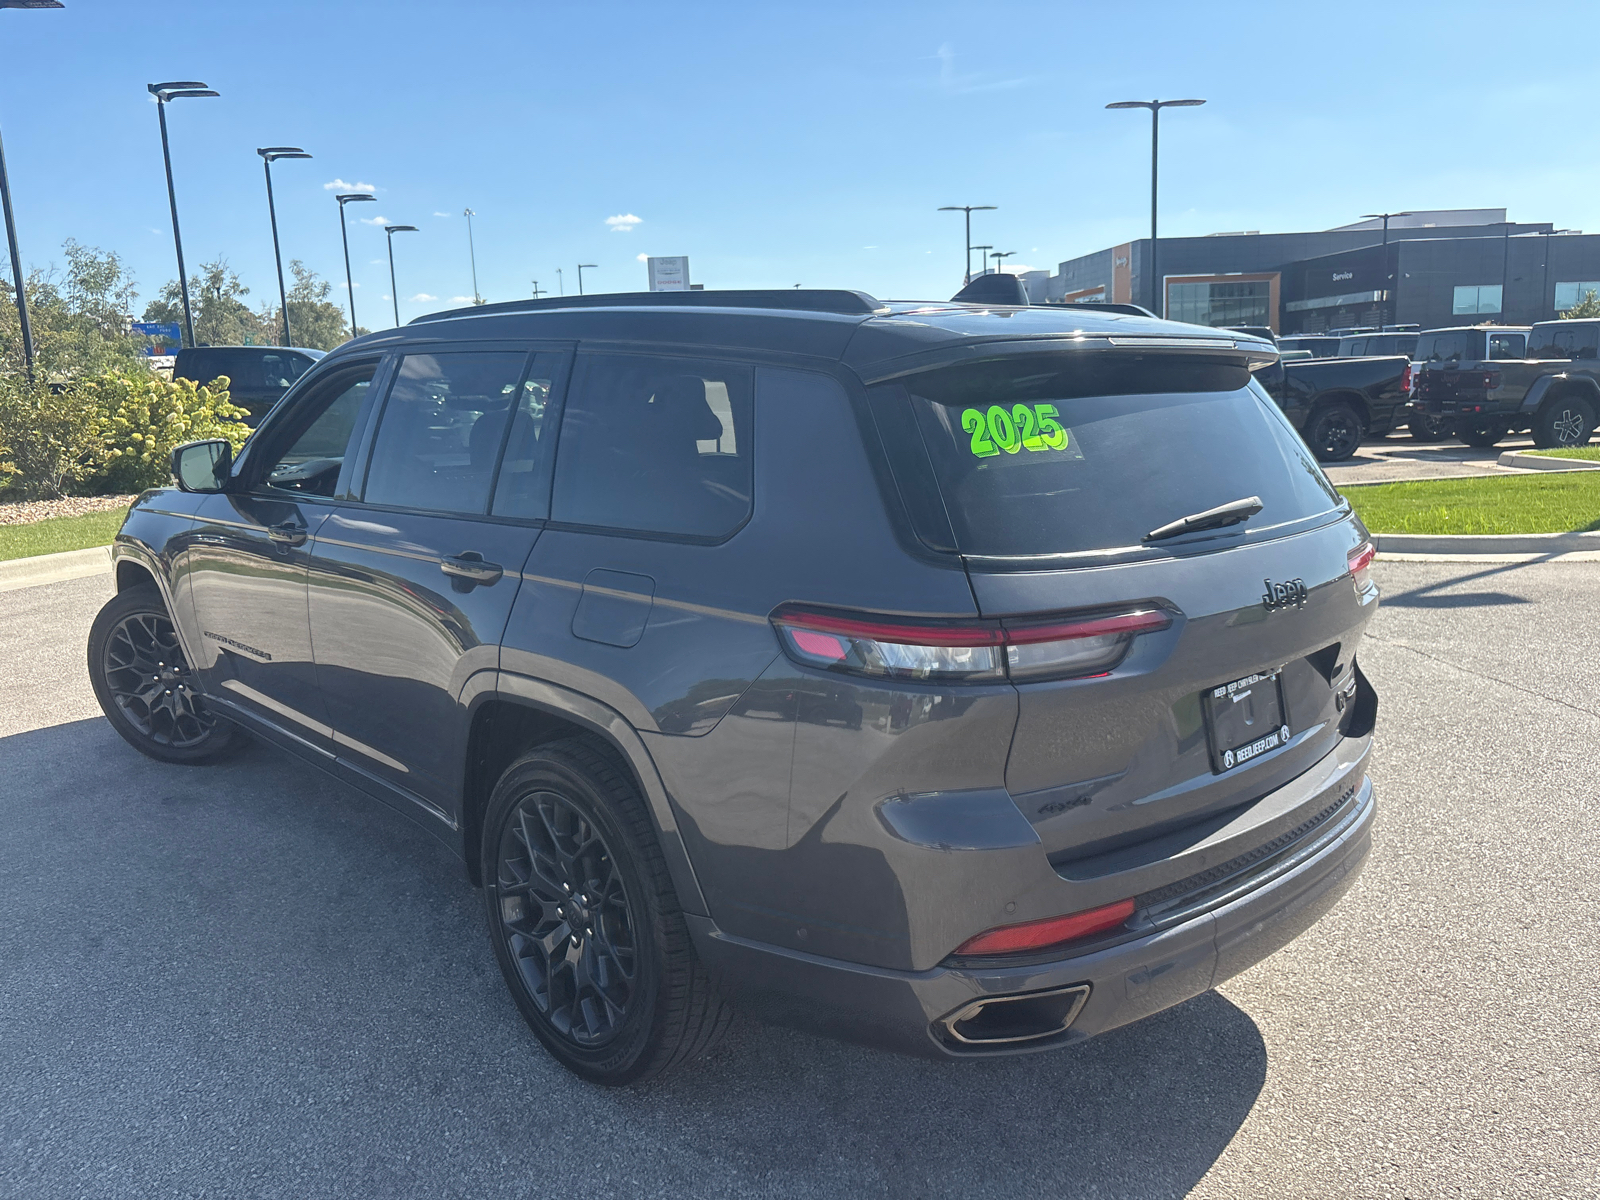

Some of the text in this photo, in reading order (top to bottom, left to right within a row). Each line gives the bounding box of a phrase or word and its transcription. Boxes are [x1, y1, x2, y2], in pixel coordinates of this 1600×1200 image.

[1332, 271, 1353, 282] Service
[1440, 373, 1460, 384] Jeep
[961, 403, 1069, 459] 2025
[1262, 577, 1308, 613] Jeep
[1213, 686, 1226, 698] REED
[1227, 681, 1238, 693] JEEP
[1237, 674, 1259, 689] CHRYSLER
[1236, 733, 1279, 763] REEDJEEP.COM
